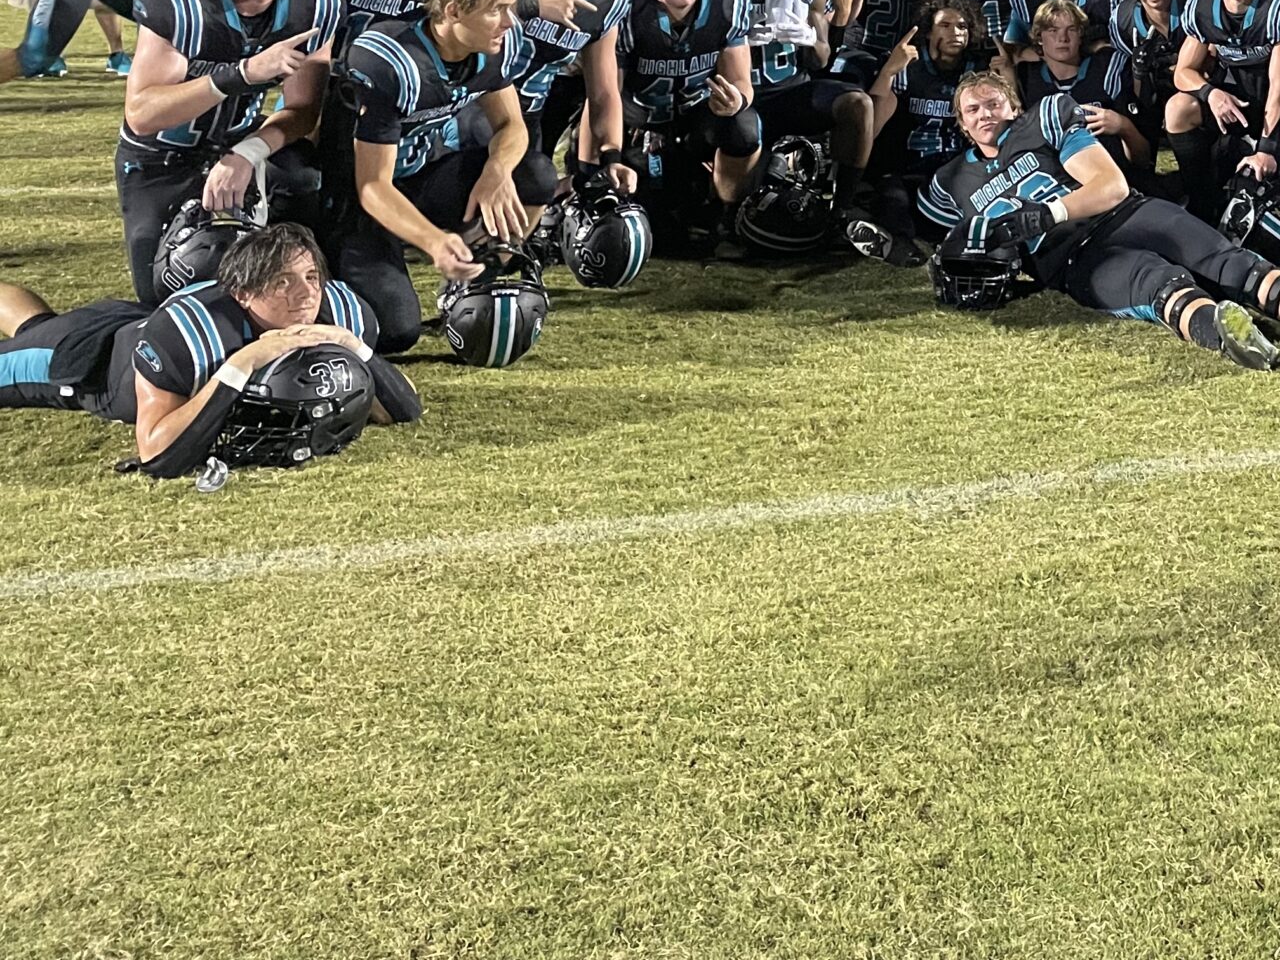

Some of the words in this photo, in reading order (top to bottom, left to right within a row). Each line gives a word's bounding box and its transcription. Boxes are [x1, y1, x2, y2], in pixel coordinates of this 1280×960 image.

[523, 16, 592, 51] GHLAND
[637, 50, 721, 77] HIGHLAND
[909, 97, 958, 118] HIGHL
[969, 151, 1041, 213] HIGHLAND
[308, 357, 354, 398] 37
